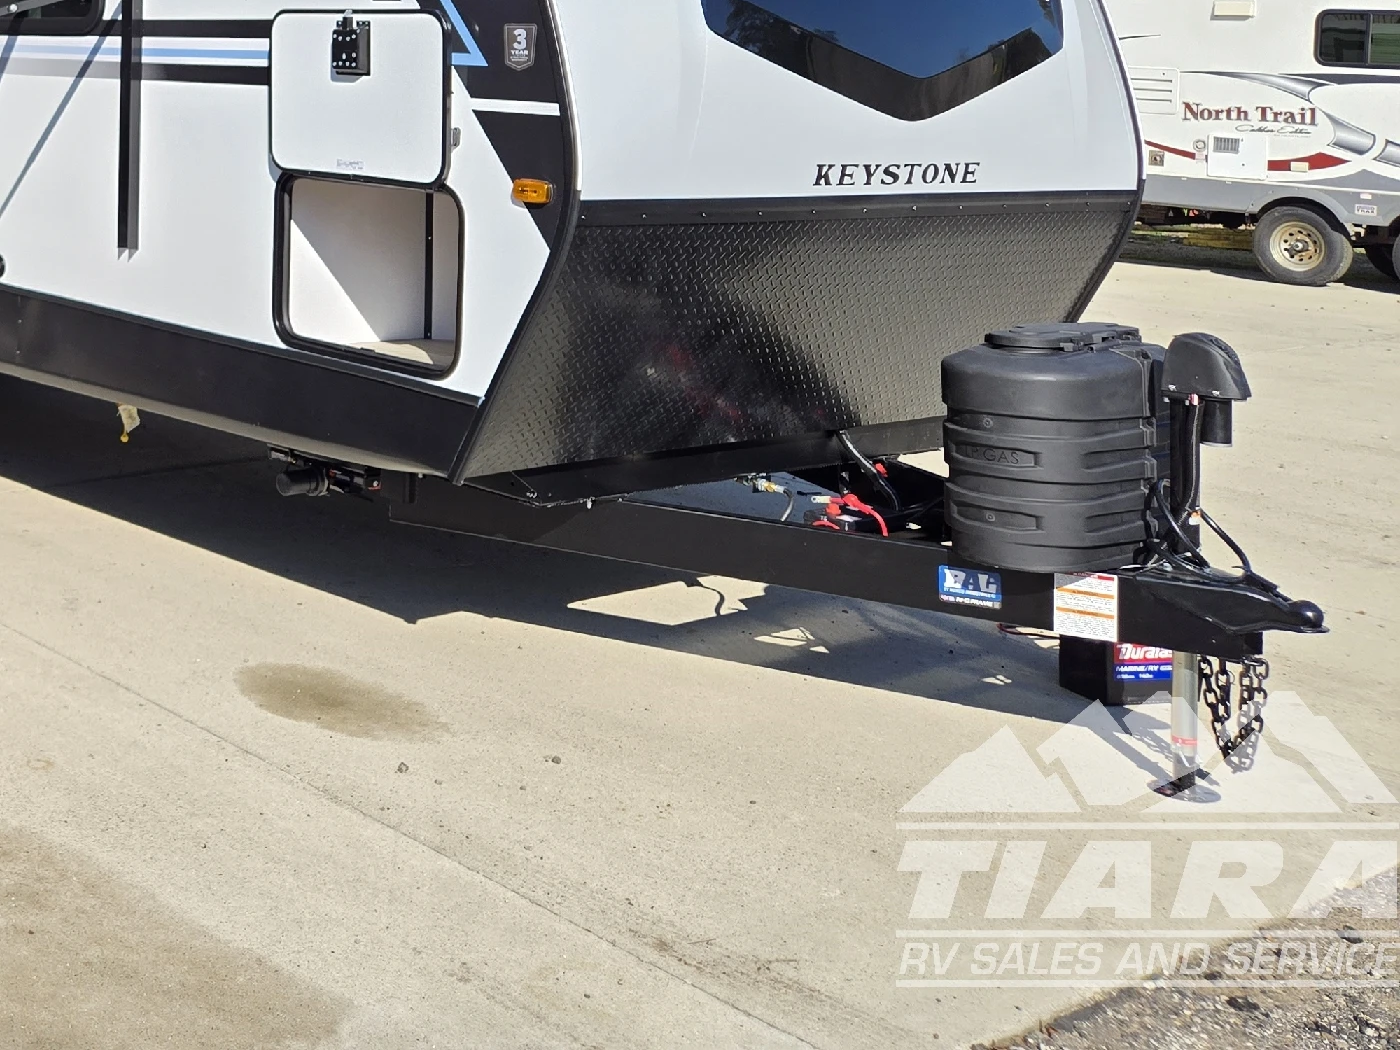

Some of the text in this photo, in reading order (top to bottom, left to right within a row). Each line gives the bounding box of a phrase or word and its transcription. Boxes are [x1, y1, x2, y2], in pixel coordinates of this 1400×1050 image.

[513, 28, 527, 50] 3
[1182, 101, 1318, 126] North Trail
[813, 162, 980, 186] KEYSTONE
[983, 448, 1019, 464] GAS
